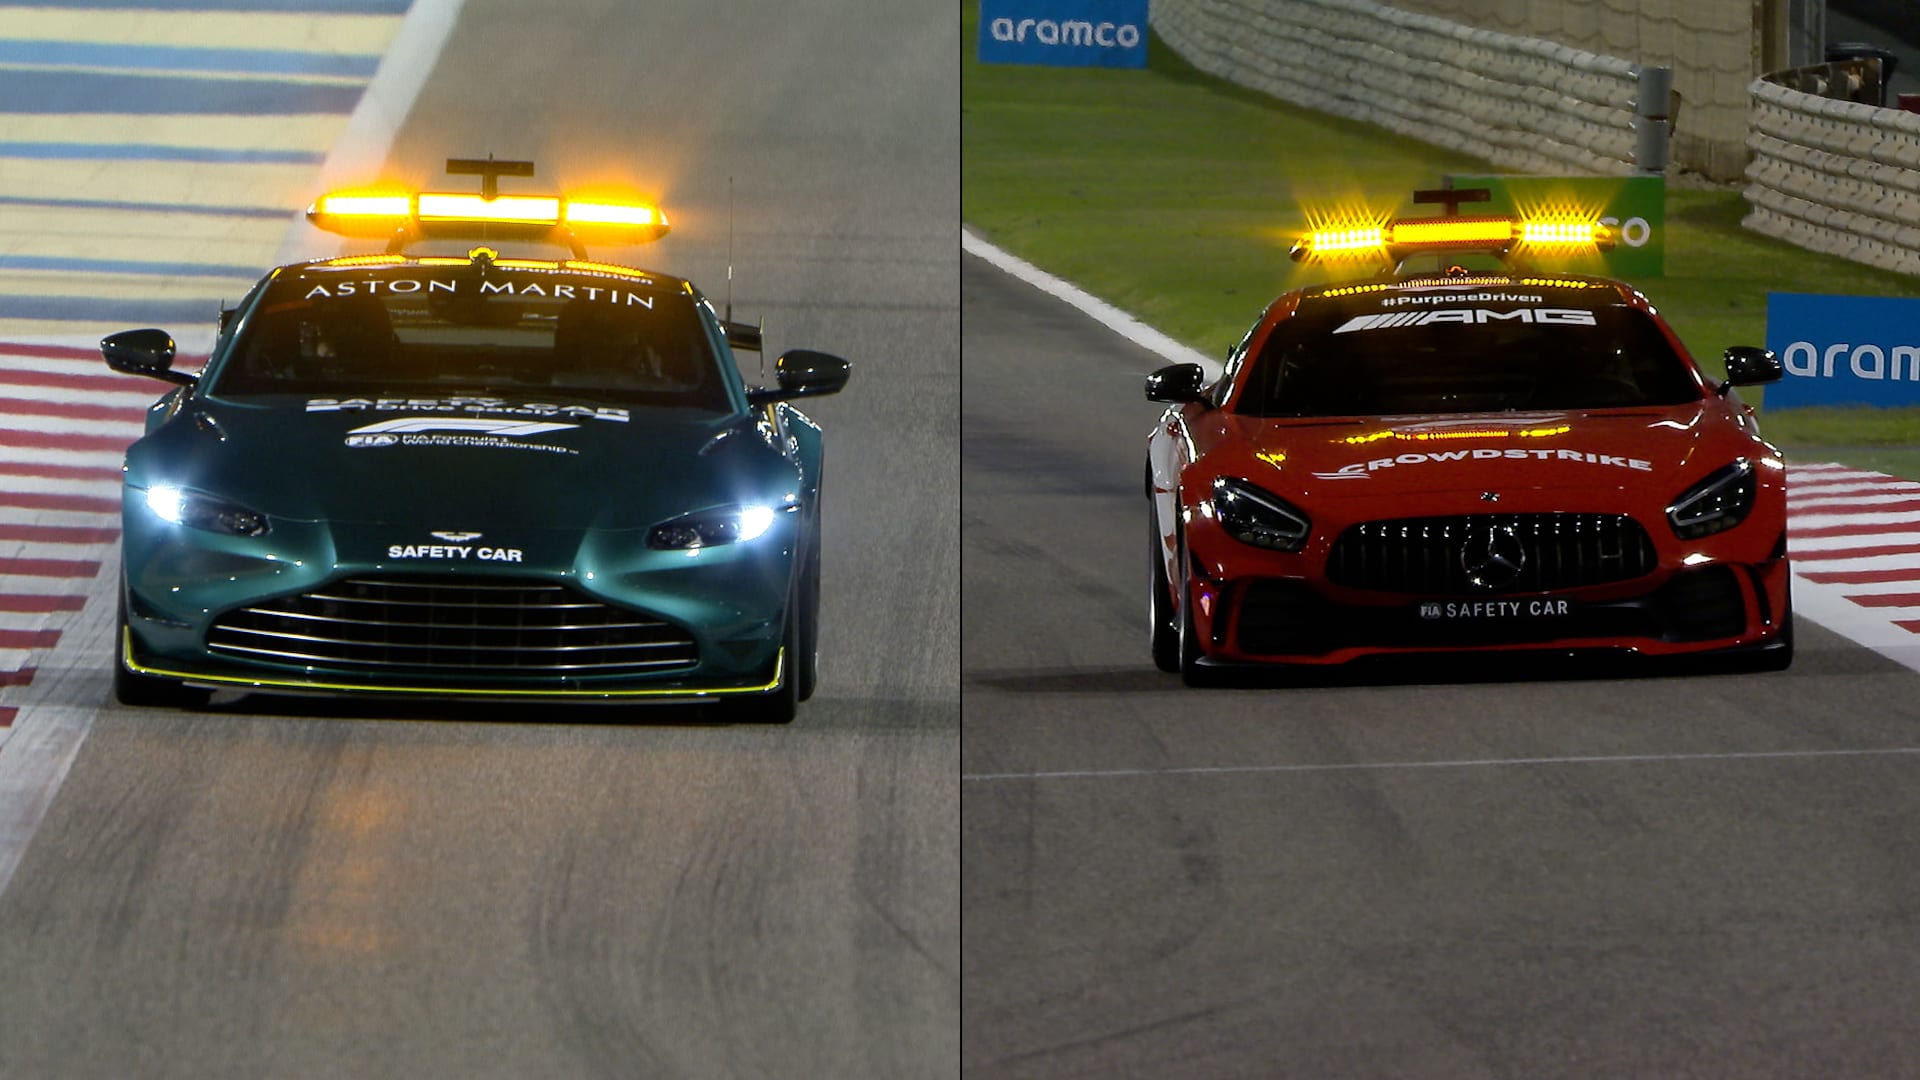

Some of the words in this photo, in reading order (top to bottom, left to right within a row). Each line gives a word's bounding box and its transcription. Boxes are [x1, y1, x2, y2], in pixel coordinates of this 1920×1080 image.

[991, 17, 1140, 48] aramco
[304, 279, 456, 300] ASTON
[479, 280, 655, 310] MARTIN
[1381, 292, 1543, 306] #PurposeDriven
[1336, 448, 1654, 475] CROWDSTRIKE
[388, 545, 472, 559] SAFETY
[477, 547, 523, 562] CAR
[1420, 604, 1441, 618] FIA
[1446, 602, 1520, 617] SAFETY
[1529, 600, 1568, 616] CAR
